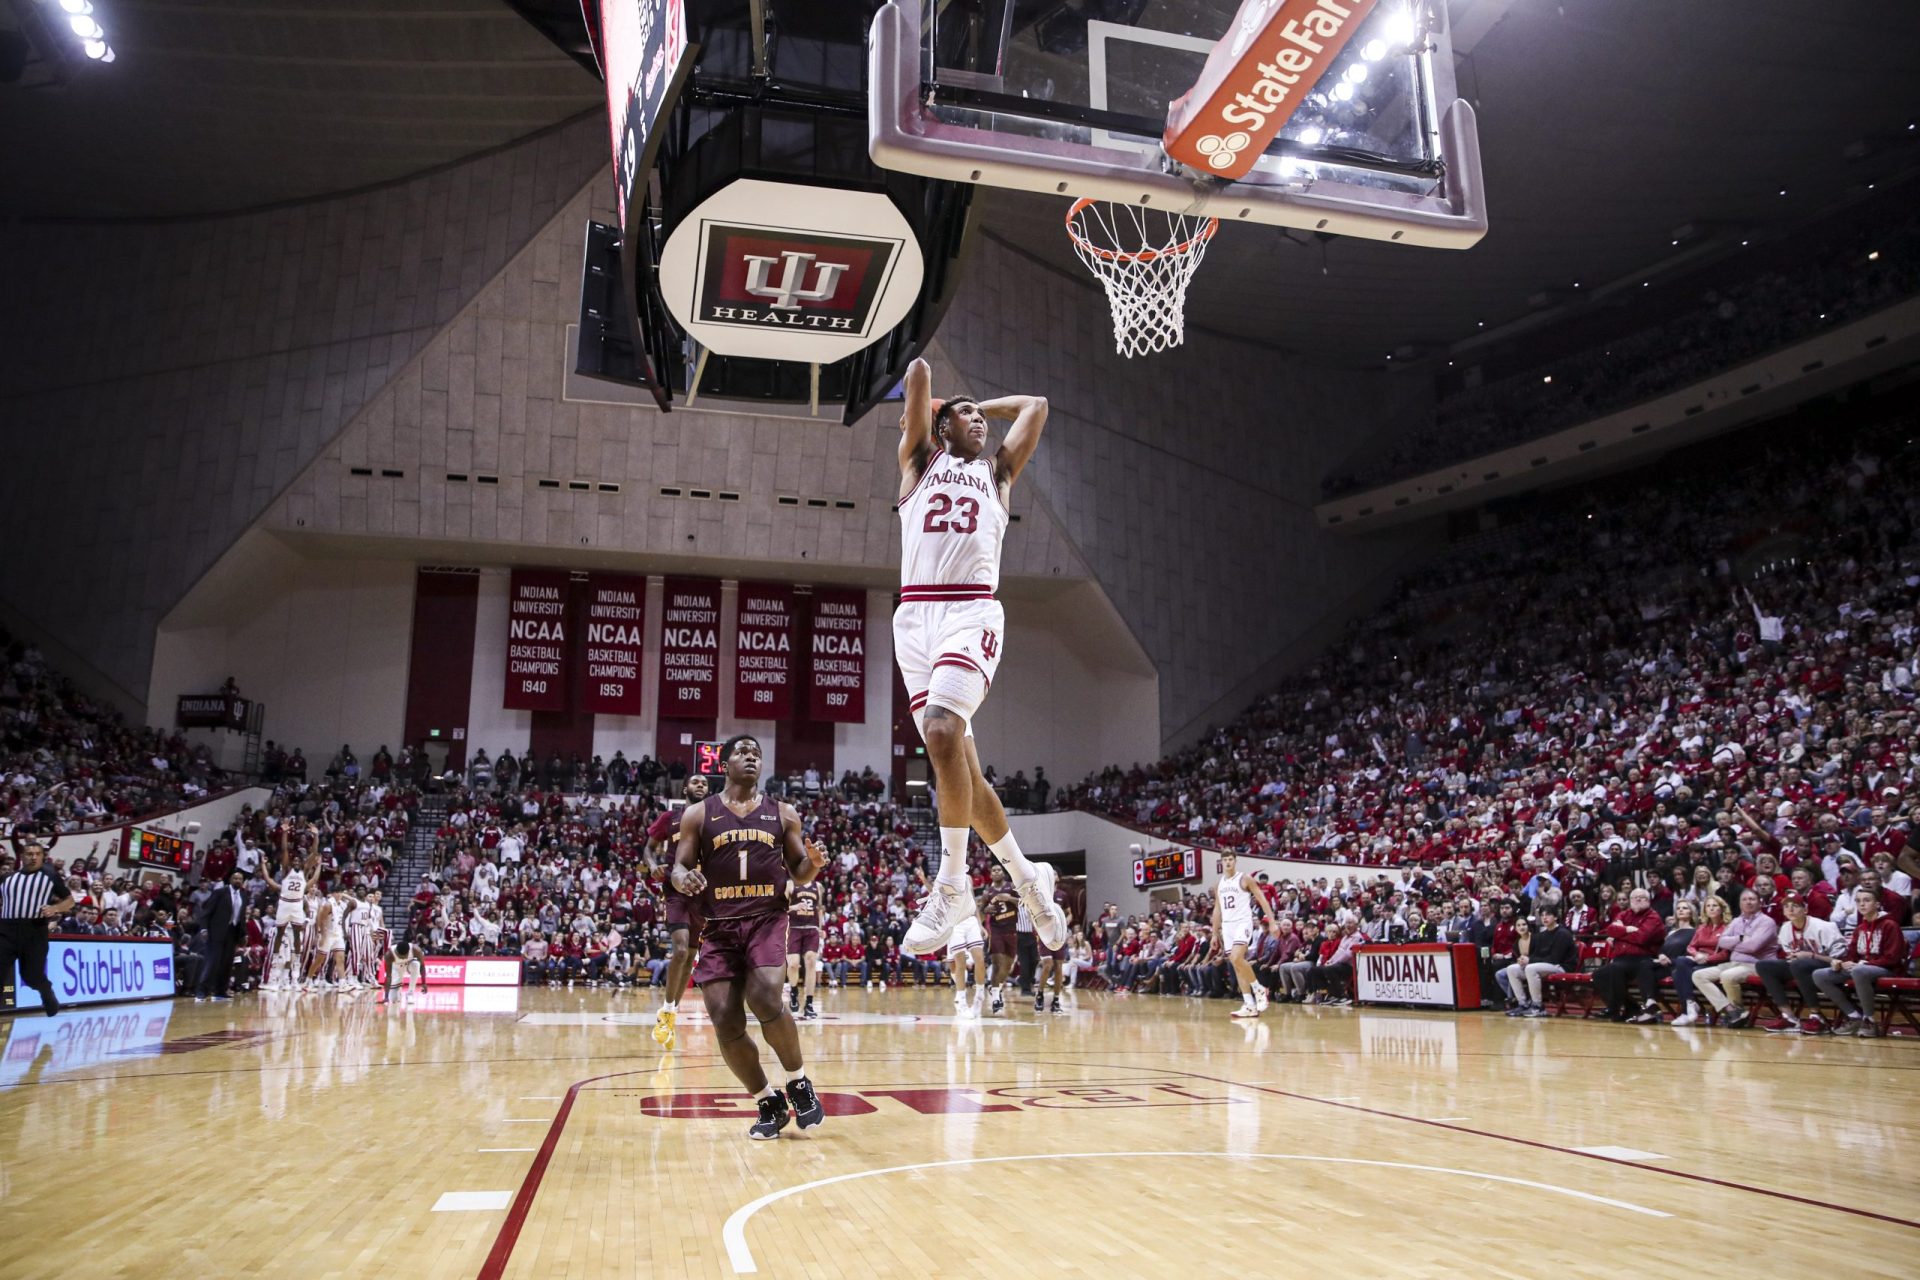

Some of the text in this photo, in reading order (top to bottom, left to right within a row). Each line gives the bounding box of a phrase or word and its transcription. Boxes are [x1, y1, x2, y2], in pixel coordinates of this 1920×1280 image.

[1280, 0, 1361, 54] Far
[711, 306, 854, 329] HEALTH
[924, 469, 990, 499] INDIANA
[923, 492, 980, 534] 23
[520, 586, 559, 599] INDIANA
[598, 590, 636, 604] INDIANA
[513, 600, 564, 615] UNIVERSITY
[673, 594, 712, 608] INDIANA
[747, 598, 784, 612] INDIANA
[591, 605, 641, 620] UNIVERSITY
[666, 609, 717, 623] UNIVERSITY
[821, 602, 857, 616] INDIANA
[740, 612, 790, 627] UNIVERSITY
[814, 616, 862, 630] UNIVERSITY
[510, 620, 564, 641] NCAA
[588, 623, 641, 645] NCAA
[664, 628, 717, 648] NCAA
[738, 631, 790, 652] NCAA
[812, 634, 863, 655] NCAA
[510, 645, 561, 660] BASKETBALL
[588, 649, 638, 664] BASKETBALL
[664, 653, 715, 667] BASKETBALL
[511, 661, 559, 675] CHAMPIONS
[739, 655, 788, 669] BASKETBALL
[814, 658, 861, 673] BASKETBALL
[590, 664, 636, 679] CHAMPIONS
[666, 668, 712, 682] CHAMPIONS
[740, 671, 786, 684] CHAMPIONS
[522, 680, 547, 693] 1940
[815, 673, 860, 688] CHAMPIONS
[600, 683, 623, 697] 1953
[678, 687, 700, 700] 1976
[753, 690, 773, 702] 1981
[181, 700, 225, 711] INDIANA
[826, 693, 848, 706] 1987
[712, 828, 776, 851] BETHUNE
[738, 850, 748, 881] 1
[288, 881, 301, 892] 22
[714, 884, 775, 900] COOKMAN
[1223, 895, 1235, 910] 12
[63, 948, 144, 997] StubHub
[1366, 955, 1440, 983] INDIANA
[1375, 983, 1432, 1000] BASKETBALL
